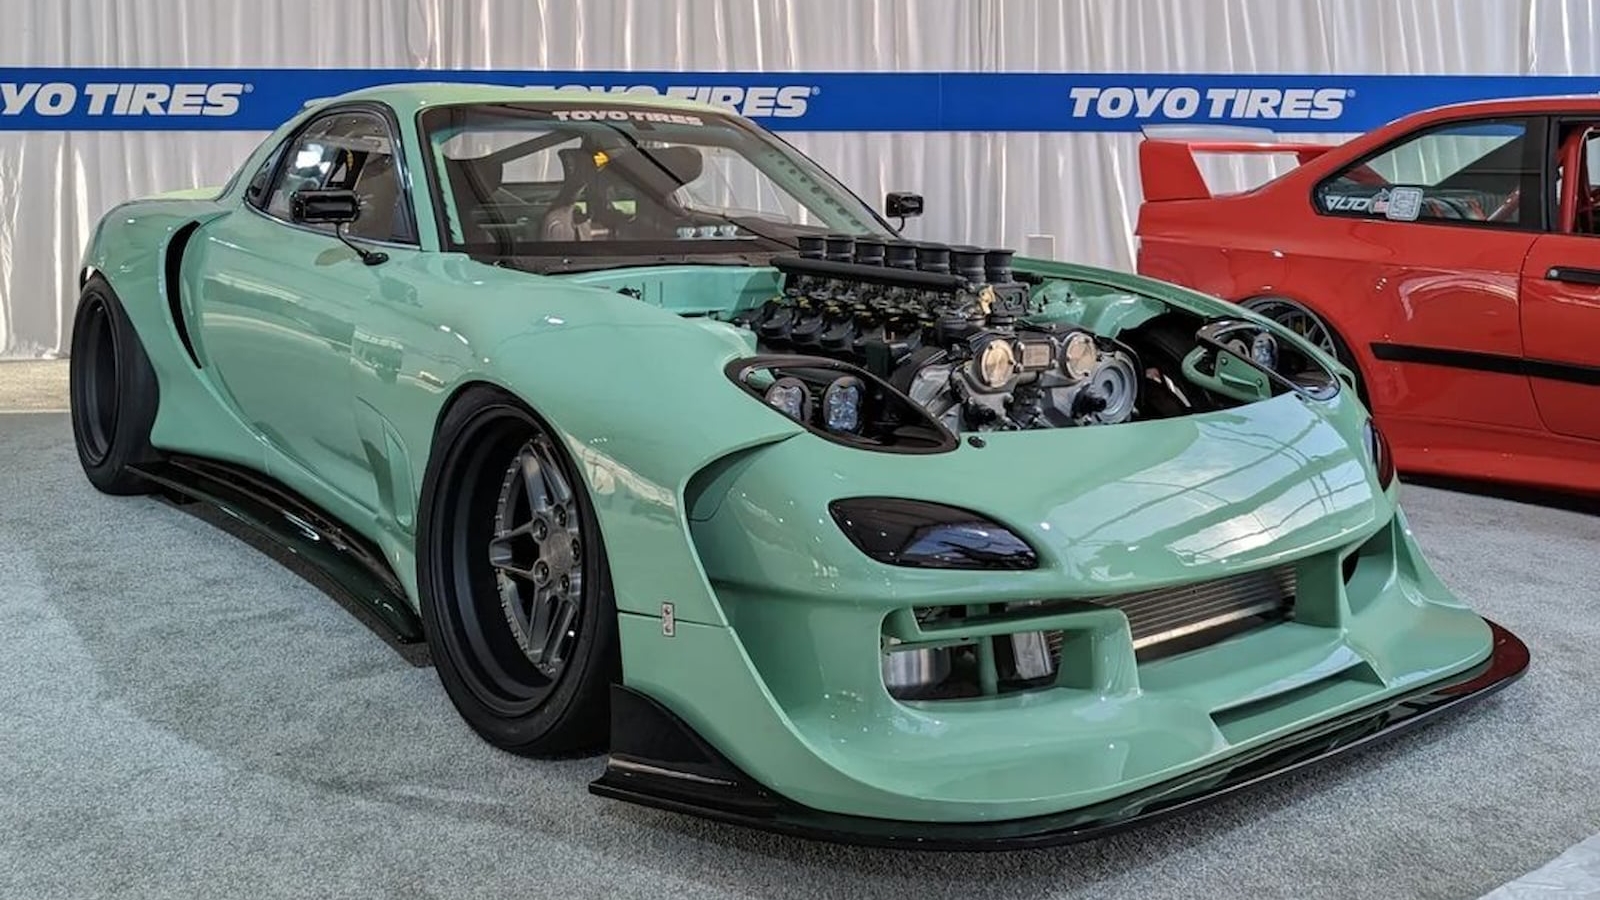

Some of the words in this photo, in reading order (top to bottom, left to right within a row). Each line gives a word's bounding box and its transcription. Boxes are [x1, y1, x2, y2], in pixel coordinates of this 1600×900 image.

[84, 83, 244, 116] TIRES
[1069, 87, 1200, 119] TOYO
[1206, 88, 1346, 119] TIRES
[552, 110, 629, 121] TOYO
[629, 112, 703, 126] TIRES
